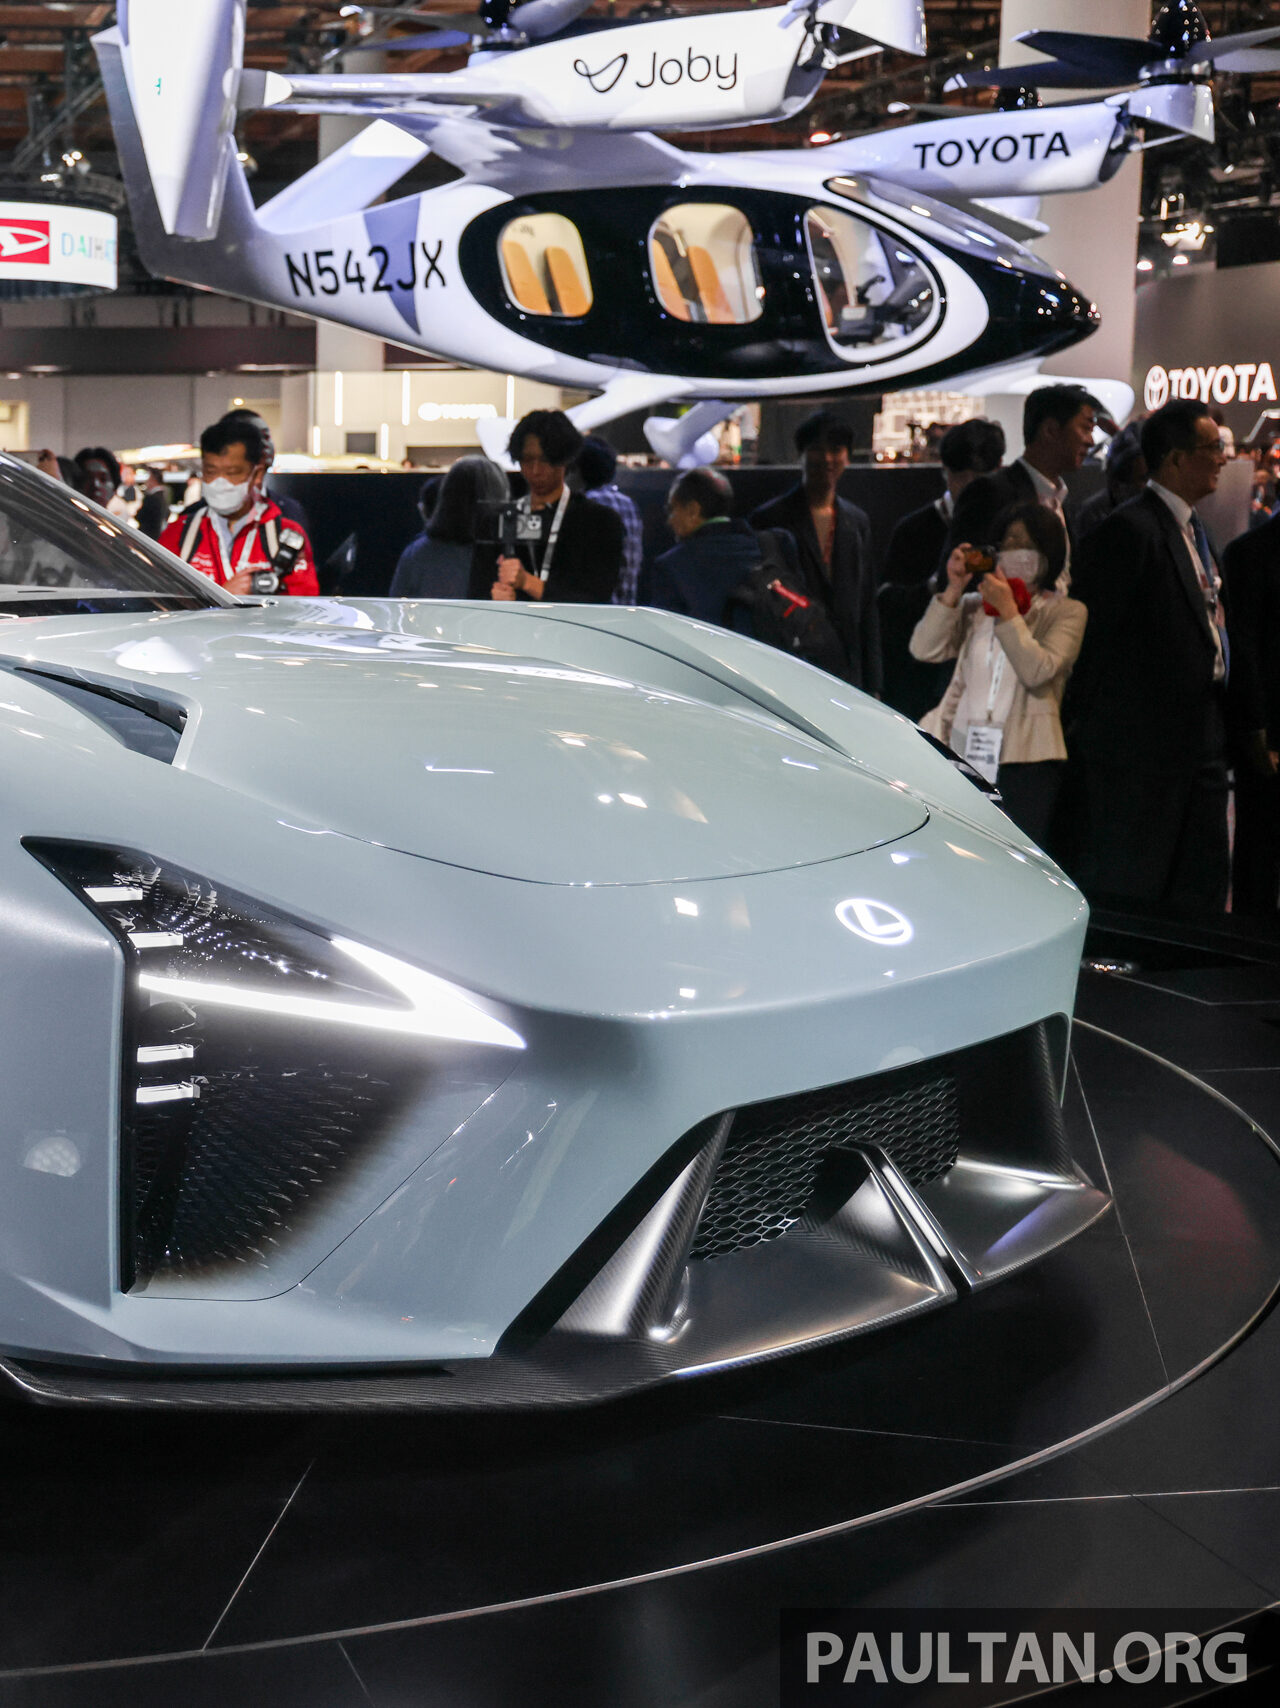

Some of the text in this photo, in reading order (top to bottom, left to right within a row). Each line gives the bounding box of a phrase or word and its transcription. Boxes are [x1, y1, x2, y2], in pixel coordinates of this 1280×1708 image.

[635, 46, 738, 90] Joby
[912, 131, 1072, 169] TOYOTA
[285, 239, 447, 297] N542JX
[1167, 362, 1278, 405] TOYOTA
